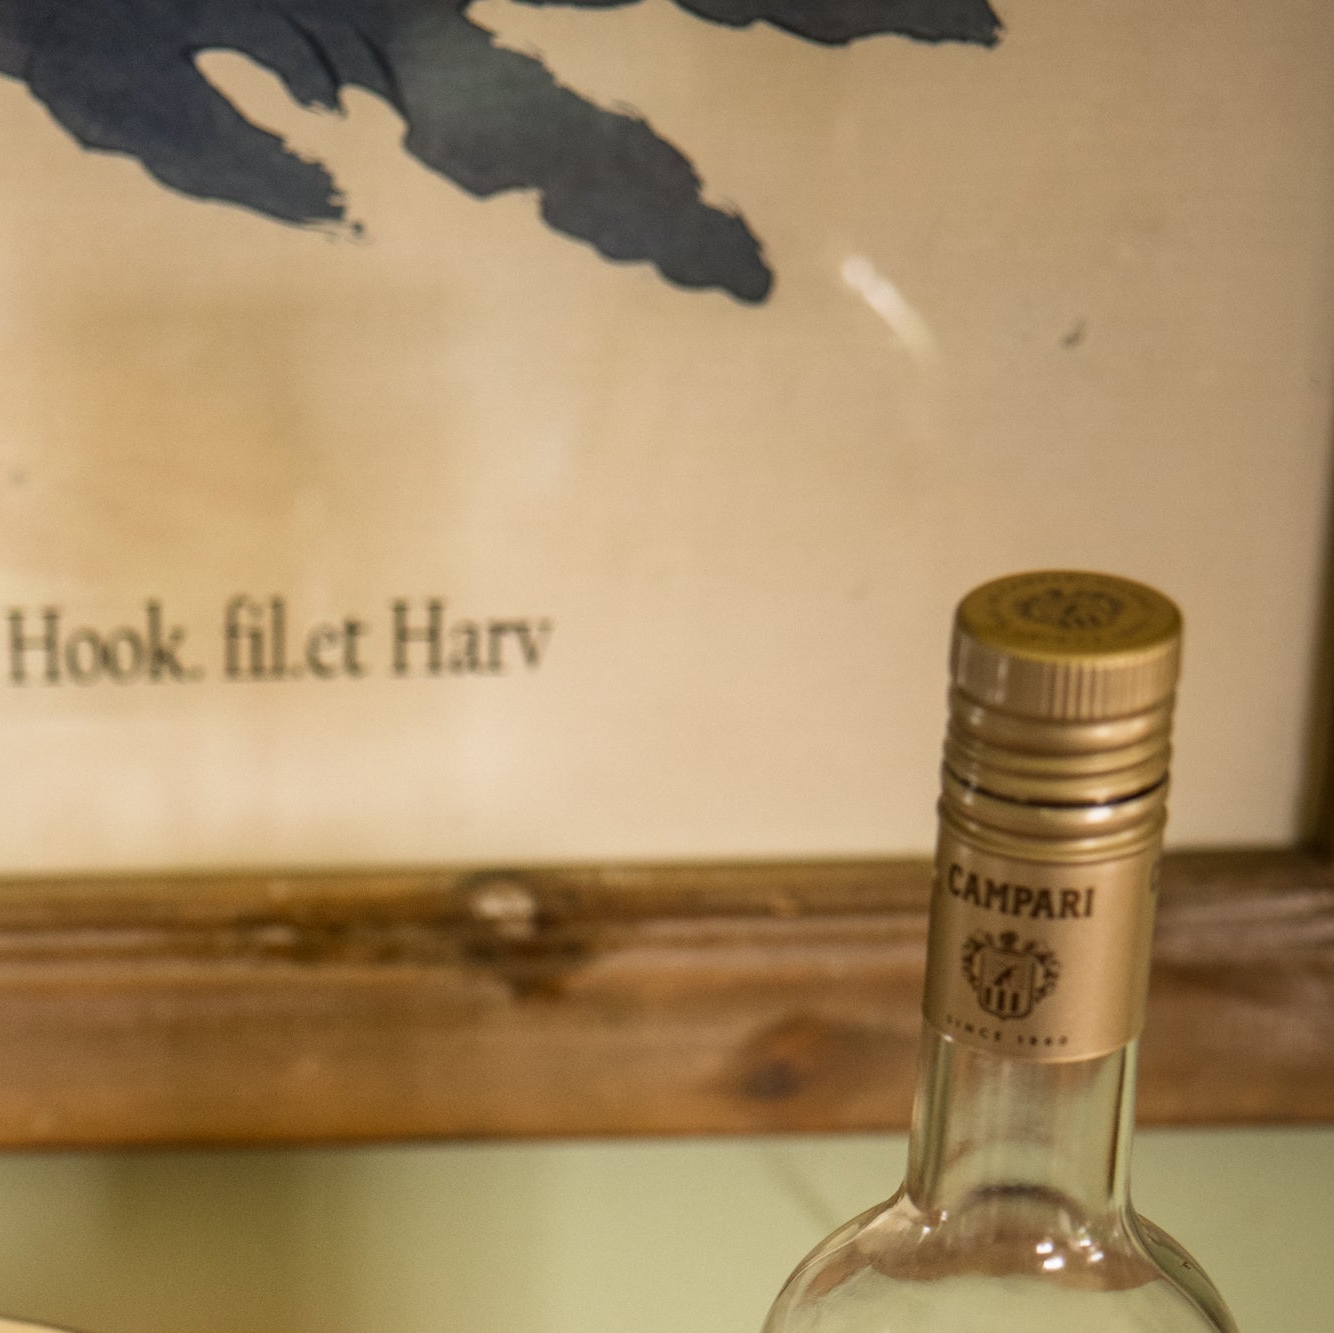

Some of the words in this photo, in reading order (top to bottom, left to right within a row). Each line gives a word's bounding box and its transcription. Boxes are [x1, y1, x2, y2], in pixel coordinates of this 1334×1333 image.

[7, 599, 205, 689] Hook.
[389, 595, 555, 678] Harv
[947, 864, 1095, 920] CAMPARI
